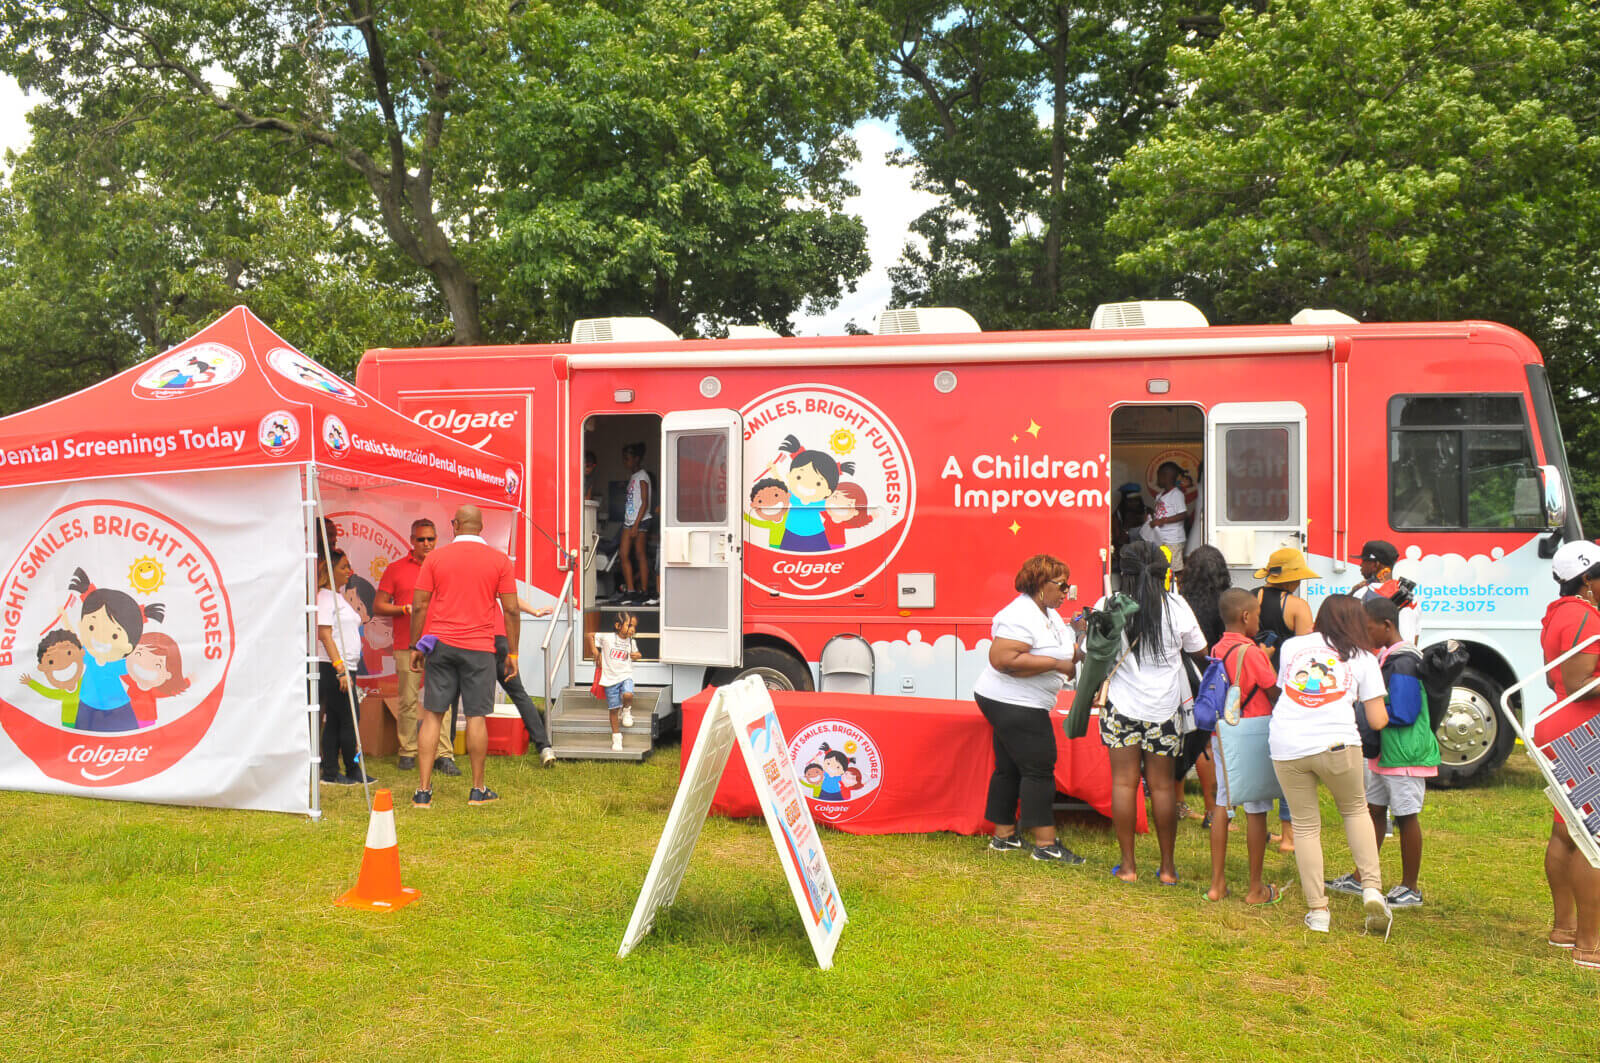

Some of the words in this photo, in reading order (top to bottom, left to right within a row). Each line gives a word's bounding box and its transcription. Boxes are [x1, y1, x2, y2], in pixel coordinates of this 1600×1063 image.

[413, 409, 517, 434] Colgate
[743, 400, 801, 441] SMILES,
[805, 398, 870, 430] BRIGHT
[63, 432, 177, 459] Screenings
[178, 425, 246, 452] Today
[351, 433, 384, 455] Gratis
[429, 452, 457, 473] Dental
[457, 464, 475, 478] para
[475, 467, 505, 487] Menores
[941, 455, 963, 479] A
[352, 522, 401, 560] BRIGHT
[772, 561, 844, 577] Colgate
[20, 517, 88, 579] SMILES,
[94, 515, 182, 556] BRIGHT
[177, 552, 222, 661] FUTURES
[1307, 583, 1326, 596] sit
[68, 745, 152, 767] Colgate
[832, 724, 864, 742] BRIGHT
[861, 741, 879, 779] FUTURES
[814, 804, 849, 813] Colgate
